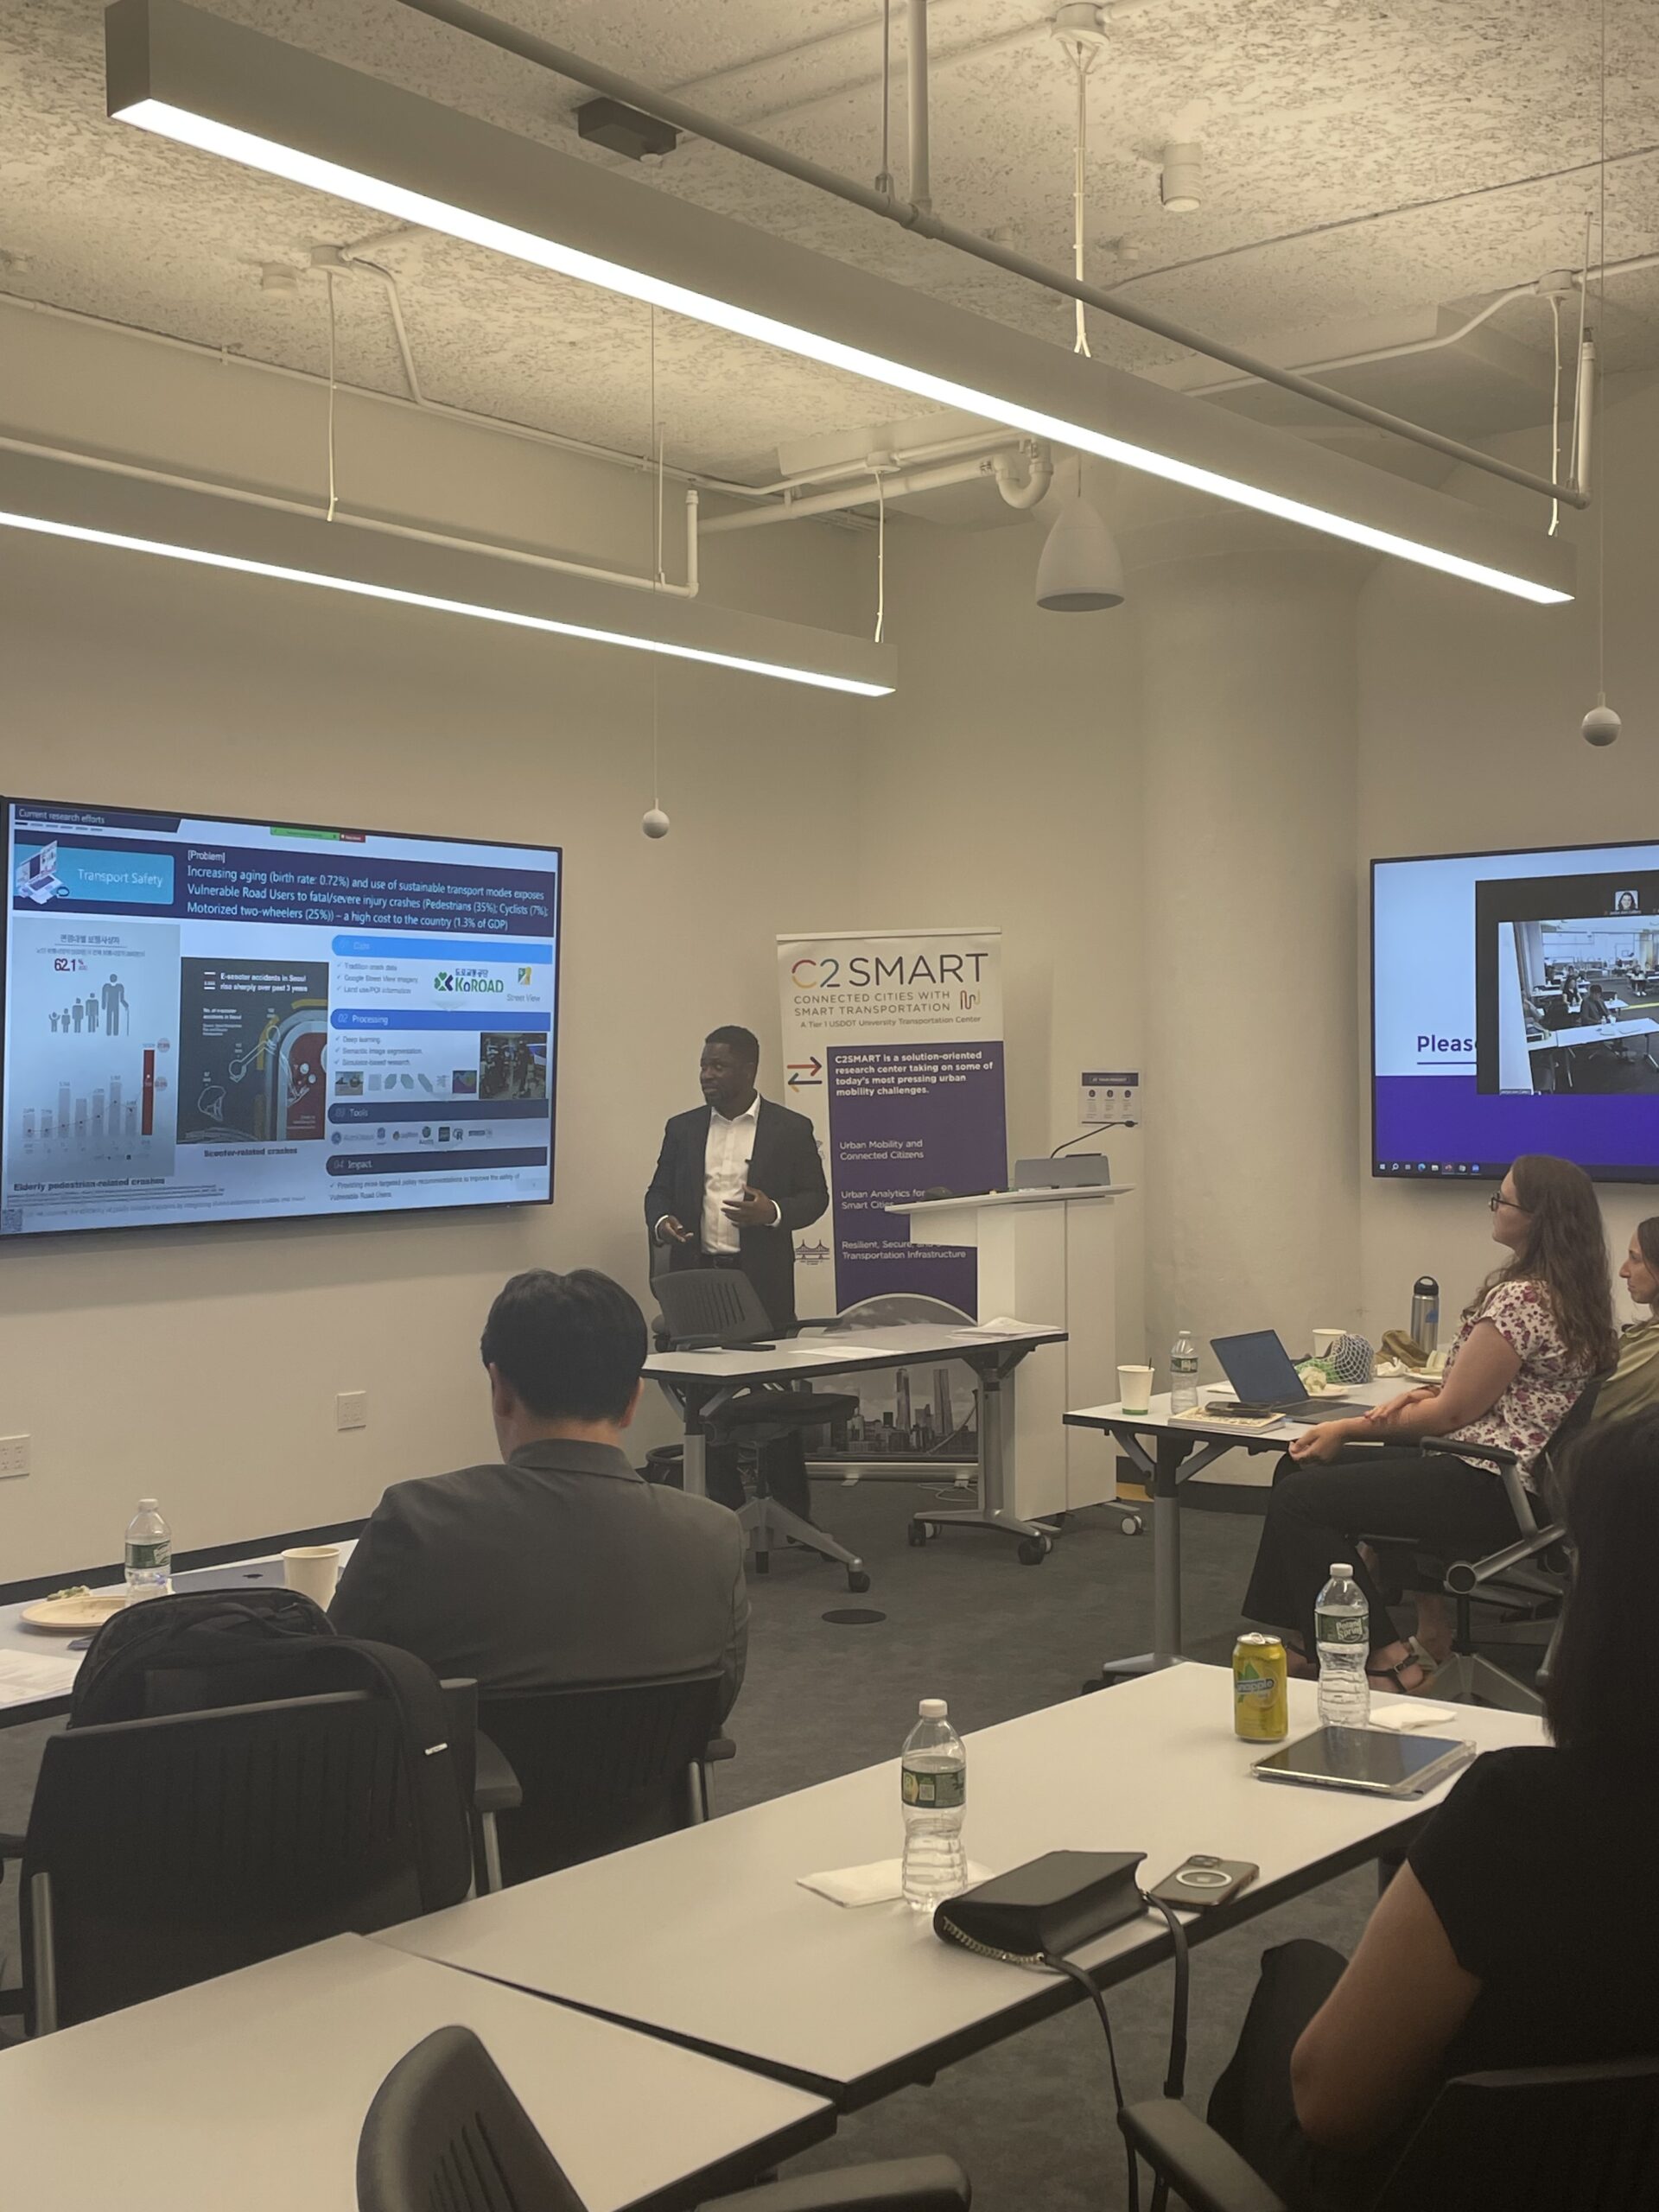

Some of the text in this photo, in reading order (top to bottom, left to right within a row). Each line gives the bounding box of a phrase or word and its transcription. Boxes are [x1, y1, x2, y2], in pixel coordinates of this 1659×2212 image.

[48, 812, 80, 822] research
[78, 868, 163, 887] Transport Safety
[188, 866, 238, 882] Increasing
[239, 870, 267, 884] aging
[270, 871, 295, 884] (birth
[319, 874, 350, 888] 0.72%)
[352, 878, 368, 888] and
[371, 881, 386, 890] use
[388, 880, 397, 890] of
[398, 882, 445, 893] sustainable
[447, 885, 484, 898] transport
[486, 887, 512, 898] modes
[514, 891, 545, 901] exposes
[188, 884, 239, 898] Vulnerable
[242, 887, 267, 899] Road
[269, 888, 296, 901] Users
[297, 891, 307, 901] to
[310, 891, 361, 905] fatal/severe
[363, 895, 387, 908] injury
[389, 897, 420, 908] crashes
[423, 898, 472, 912] (Pedestrians
[499, 903, 528, 917] Cyclists
[188, 902, 238, 916] Motorized
[240, 906, 302, 919] two-wheelers
[344, 912, 349, 921] a
[351, 912, 371, 925] high
[372, 914, 391, 924] cost
[393, 915, 403, 925] to
[404, 914, 418, 925] the
[420, 917, 451, 929] country
[454, 917, 475, 929] (1.3%
[477, 918, 486, 929] of
[487, 918, 508, 931] GDP)
[455, 977, 504, 993] KoROAD
[794, 990, 950, 1004] CONNECTED CITIES WITH
[794, 1003, 950, 1016] SMART TRANSPORTATION
[353, 1014, 389, 1026] Processing
[859, 1019, 897, 1027] University
[899, 1017, 954, 1026] Transportation
[956, 1015, 981, 1024] Center
[1417, 1034, 1477, 1052] Pleas
[835, 1054, 881, 1064] C2SMART
[883, 1053, 892, 1062] is
[901, 1051, 982, 1061] solution-oriented
[835, 1065, 875, 1074] research
[877, 1064, 907, 1073] center
[909, 1063, 938, 1073] taking
[983, 1061, 994, 1071] of
[836, 1077, 869, 1086] today's
[872, 1075, 895, 1084] most
[897, 1074, 938, 1084] pressing
[836, 1086, 930, 1096] mobility challenges.
[839, 1140, 923, 1149] Urban Mobility and
[840, 1151, 888, 1160] Connected
[347, 1159, 372, 1170] Impact
[870, 1189, 911, 1199] Analytics
[912, 1189, 925, 1198] for
[842, 1201, 868, 1210] Smart
[842, 1240, 880, 1249] Resilient,
[842, 1250, 967, 1260] Transportation Infrastructure
